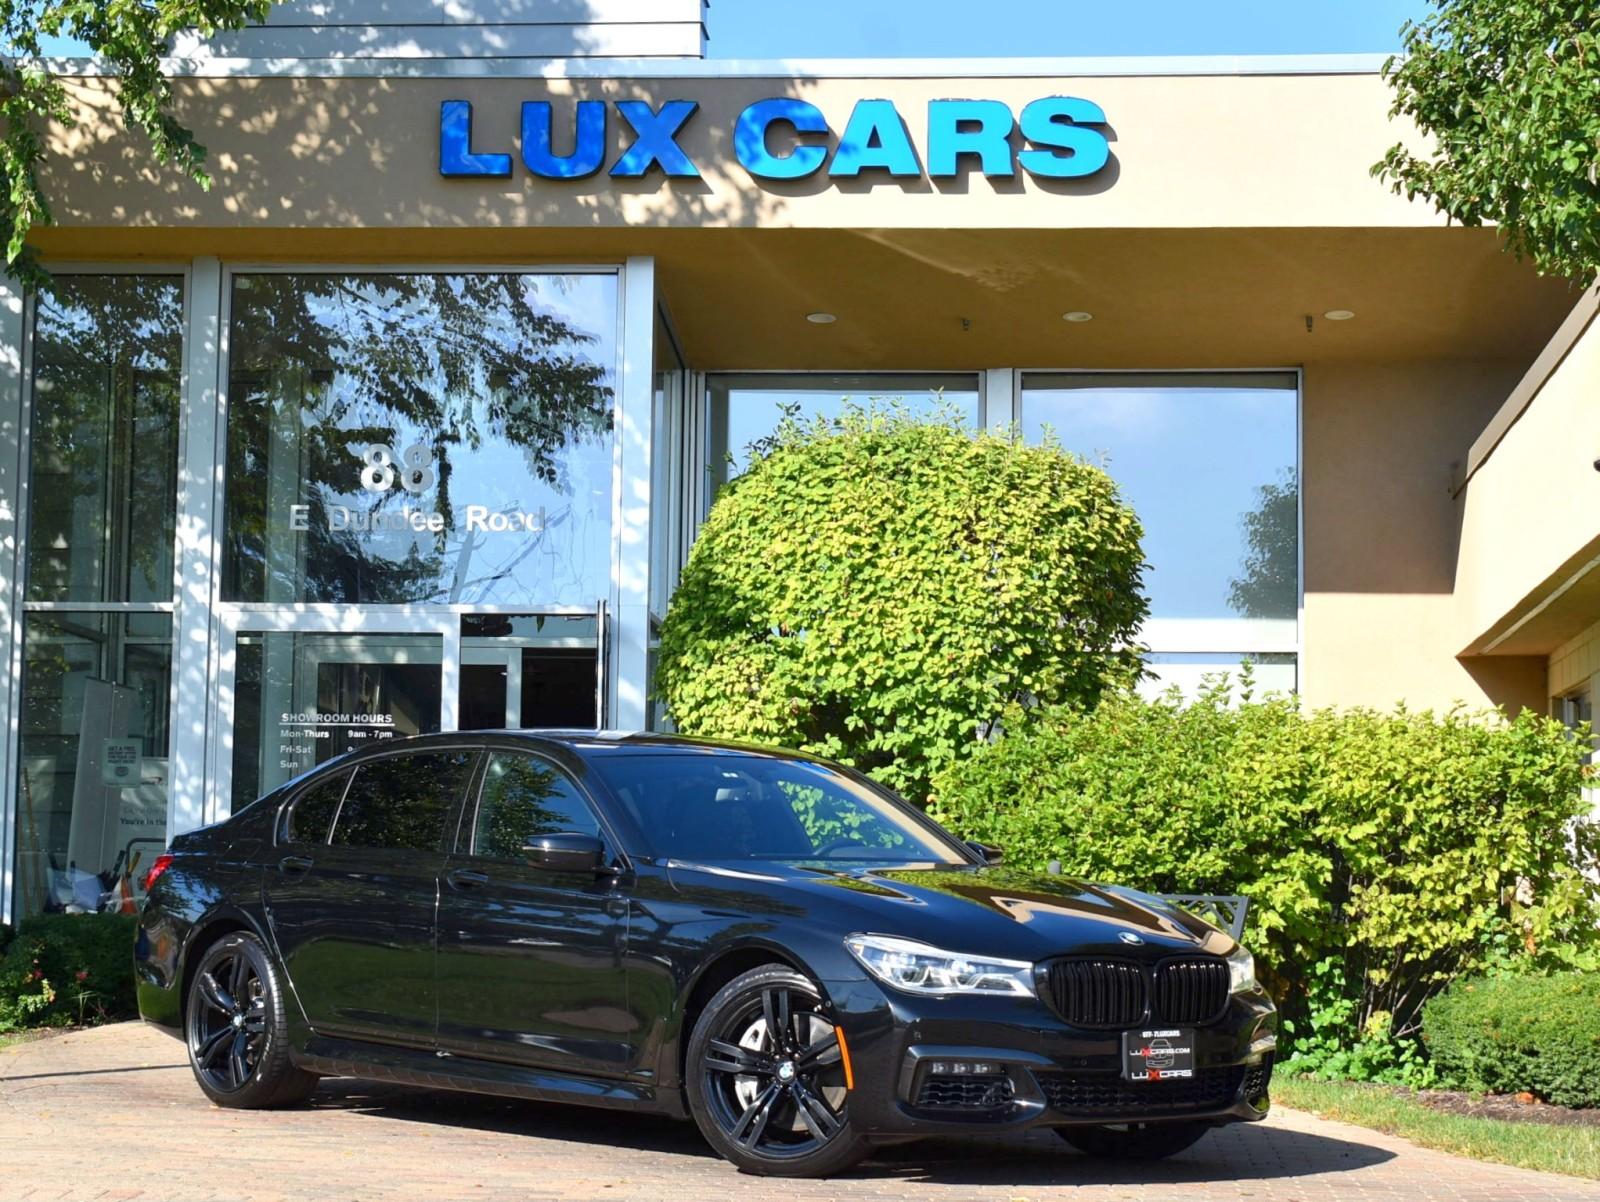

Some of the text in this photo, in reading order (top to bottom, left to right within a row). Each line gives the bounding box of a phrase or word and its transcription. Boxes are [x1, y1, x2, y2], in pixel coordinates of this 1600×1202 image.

[439, 96, 1110, 180] LUX CARS
[360, 443, 434, 492] 88
[289, 503, 545, 532] E Dundee Road
[281, 713, 393, 723] SHOWROOM HOURS
[280, 729, 330, 738] Mon-Thurs
[347, 729, 367, 738] 9am
[374, 730, 393, 740] 7pm
[280, 745, 312, 754] Fri-Sat
[280, 760, 298, 769] Sun
[1131, 1068, 1193, 1080] LUXCARS
